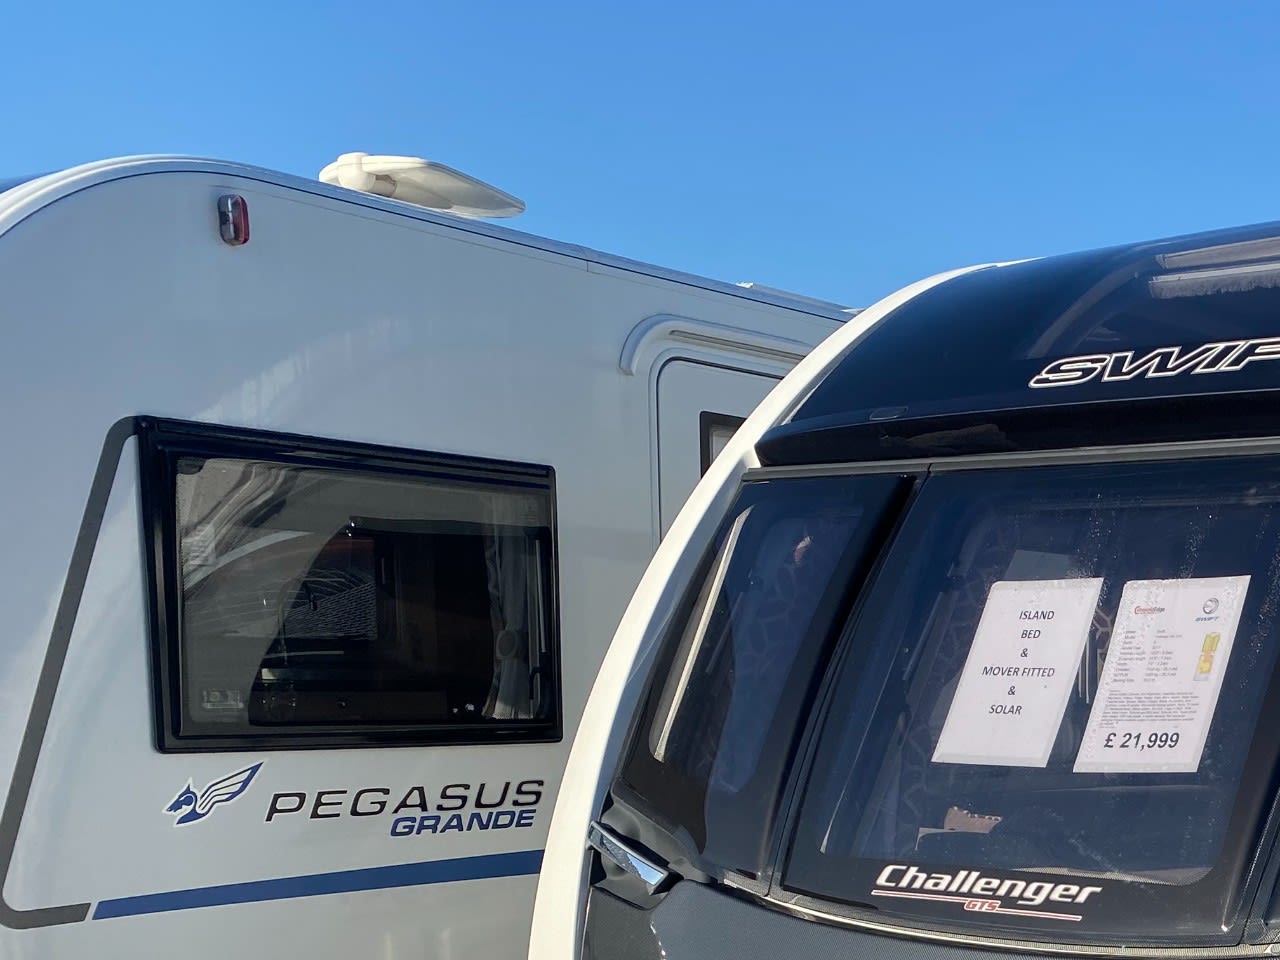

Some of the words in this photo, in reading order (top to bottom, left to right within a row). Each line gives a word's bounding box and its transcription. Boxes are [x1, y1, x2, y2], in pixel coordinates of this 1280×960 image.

[1019, 610, 1055, 620] ISLAND
[1020, 629, 1041, 639] BED
[1020, 648, 1028, 657] &
[981, 666, 1019, 676] MOVER
[1021, 667, 1055, 677] FITTED
[1007, 685, 1016, 695] &
[988, 704, 1022, 715] SOLAR
[1103, 732, 1117, 748] £
[1119, 732, 1180, 751] 21,999
[265, 779, 545, 822] PEGASUS
[389, 808, 537, 837] GRANDE
[875, 864, 1103, 904] Challenger
[965, 900, 999, 912] GTS
